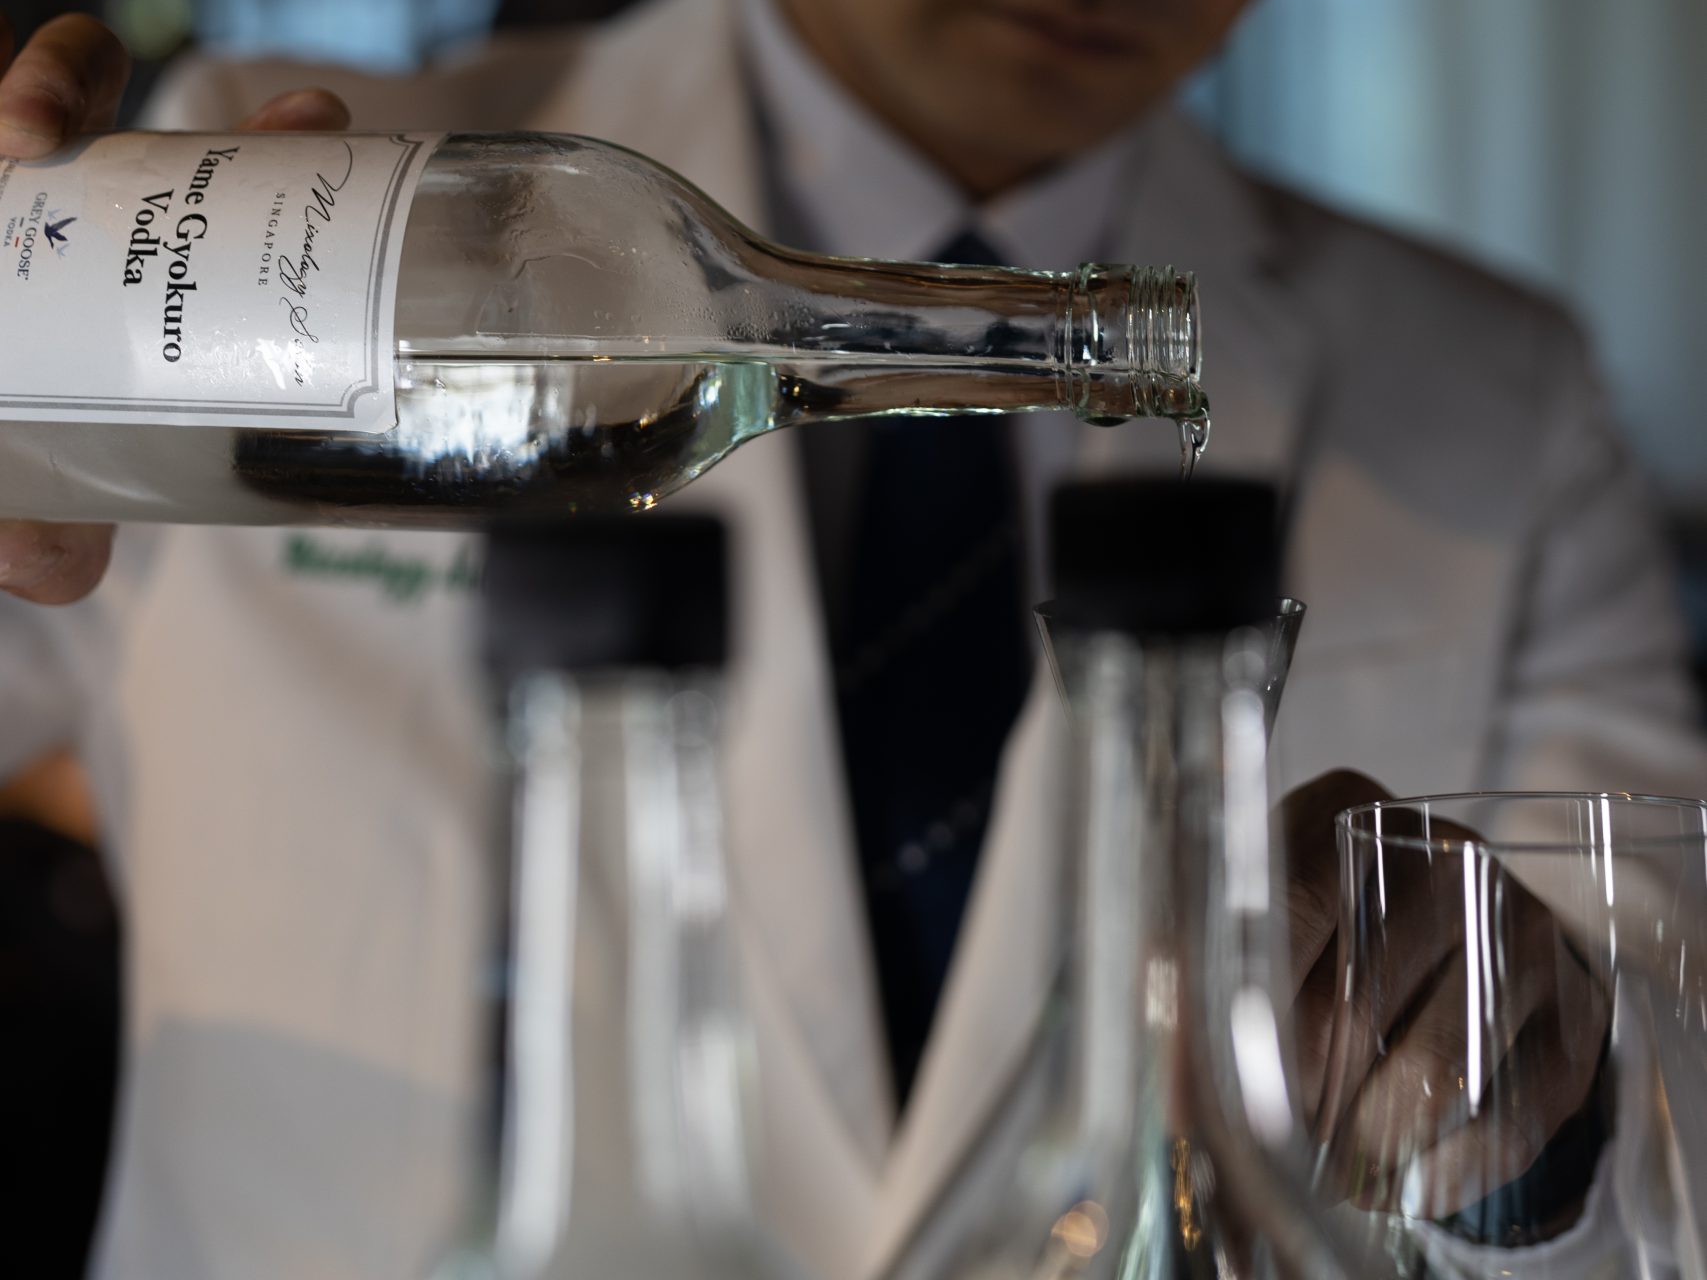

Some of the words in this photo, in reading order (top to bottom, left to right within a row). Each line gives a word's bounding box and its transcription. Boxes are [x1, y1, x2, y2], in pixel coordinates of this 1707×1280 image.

[28, 191, 48, 225] GREY
[184, 145, 241, 206] Yame
[278, 139, 353, 299] Mixology
[3, 216, 18, 247] VODKA
[17, 226, 37, 278] GOOSE
[122, 187, 175, 288] Vodka
[257, 191, 286, 287] SINGAPORE
[162, 212, 209, 364] Gyokuro
[278, 296, 320, 388] San
